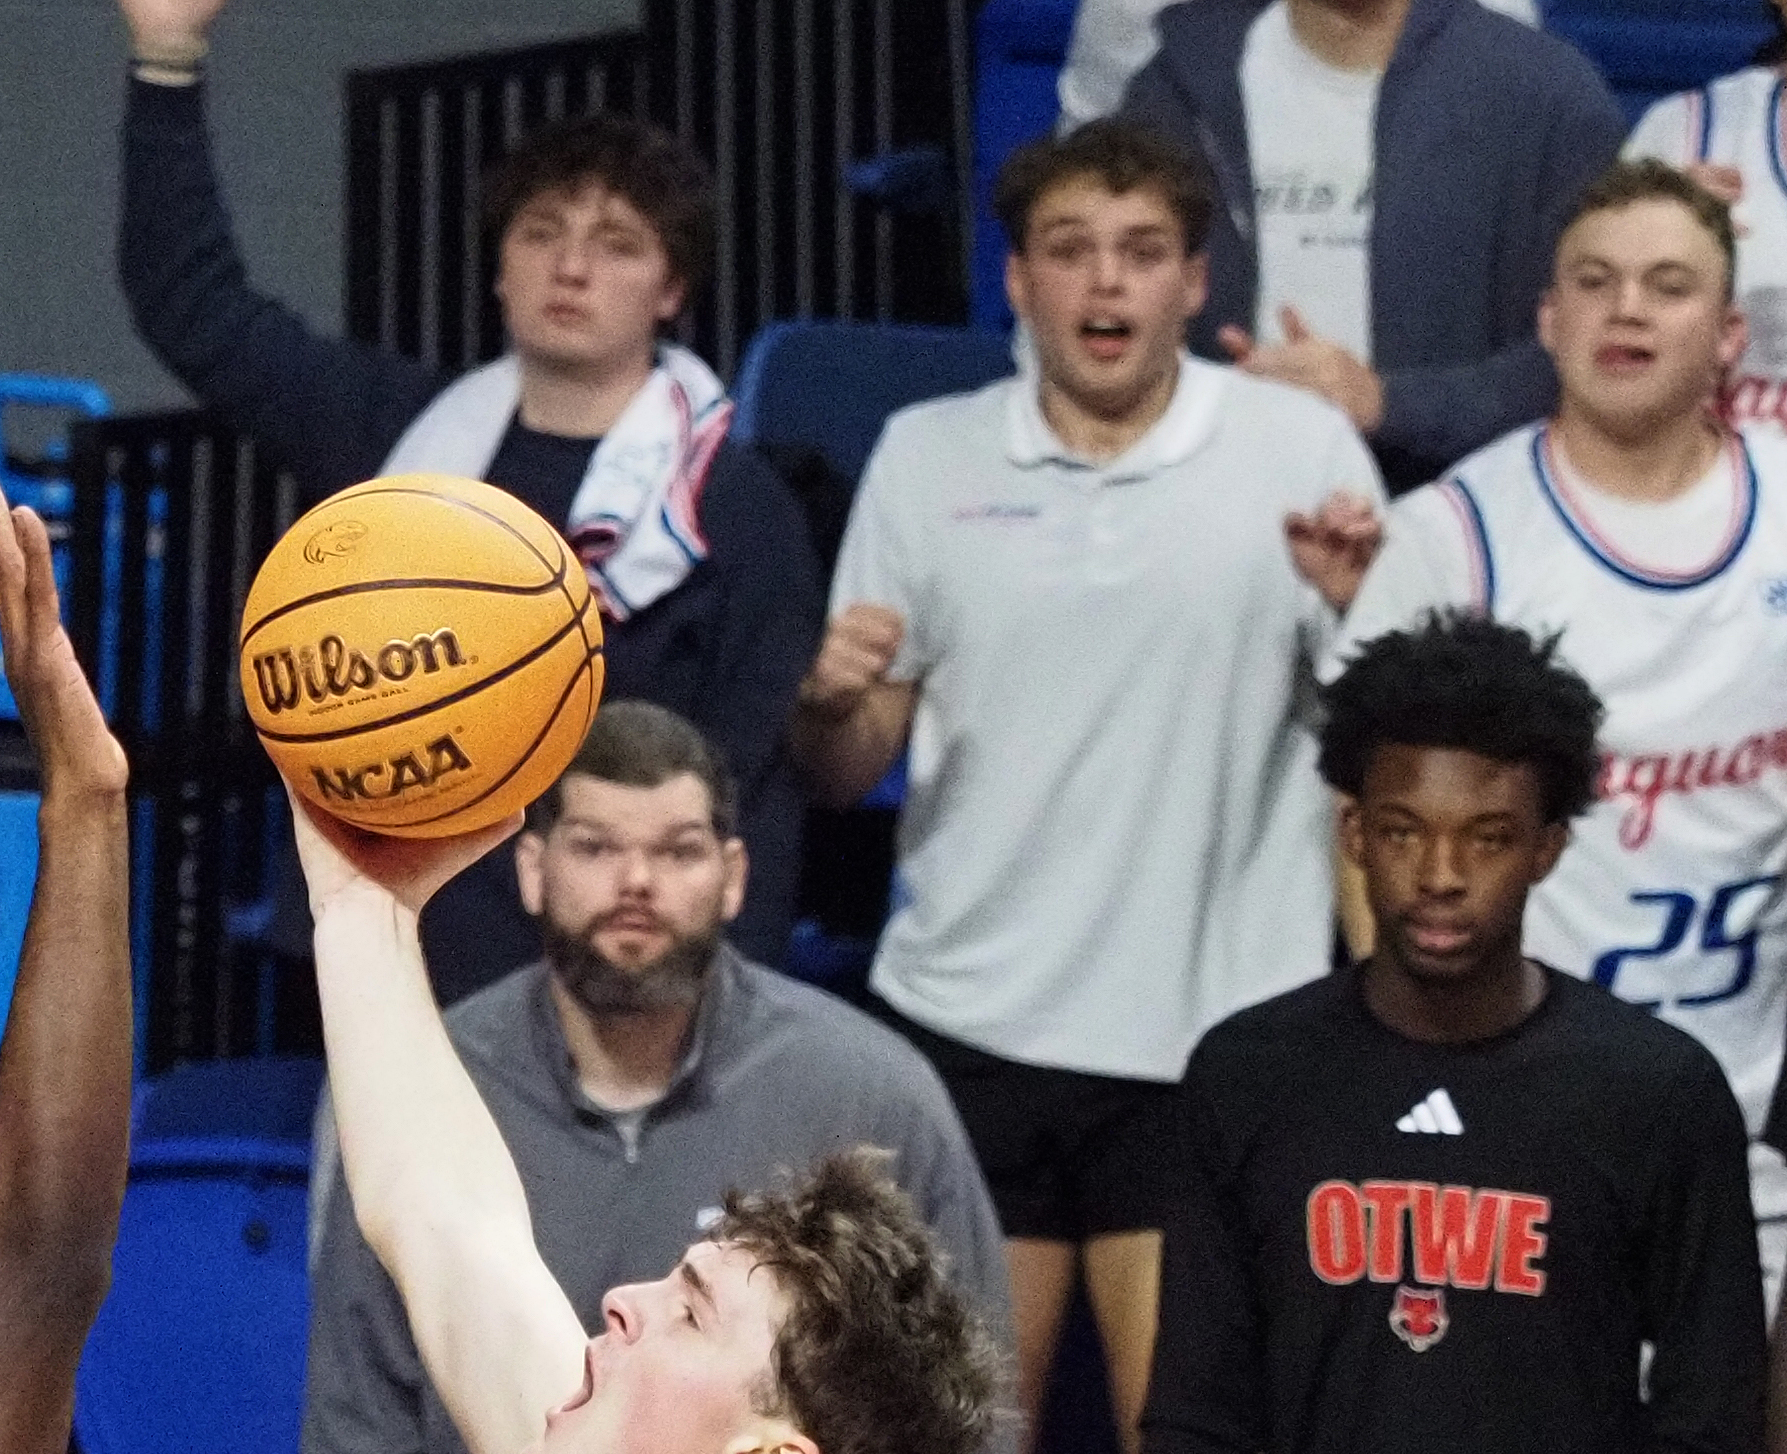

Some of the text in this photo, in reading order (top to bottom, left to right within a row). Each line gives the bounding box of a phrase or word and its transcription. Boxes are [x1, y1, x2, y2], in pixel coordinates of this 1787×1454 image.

[252, 627, 464, 715] Wilson
[310, 733, 473, 800] NCAA
[1594, 875, 1783, 1007] 25
[1307, 1179, 1553, 1298] OTWE
